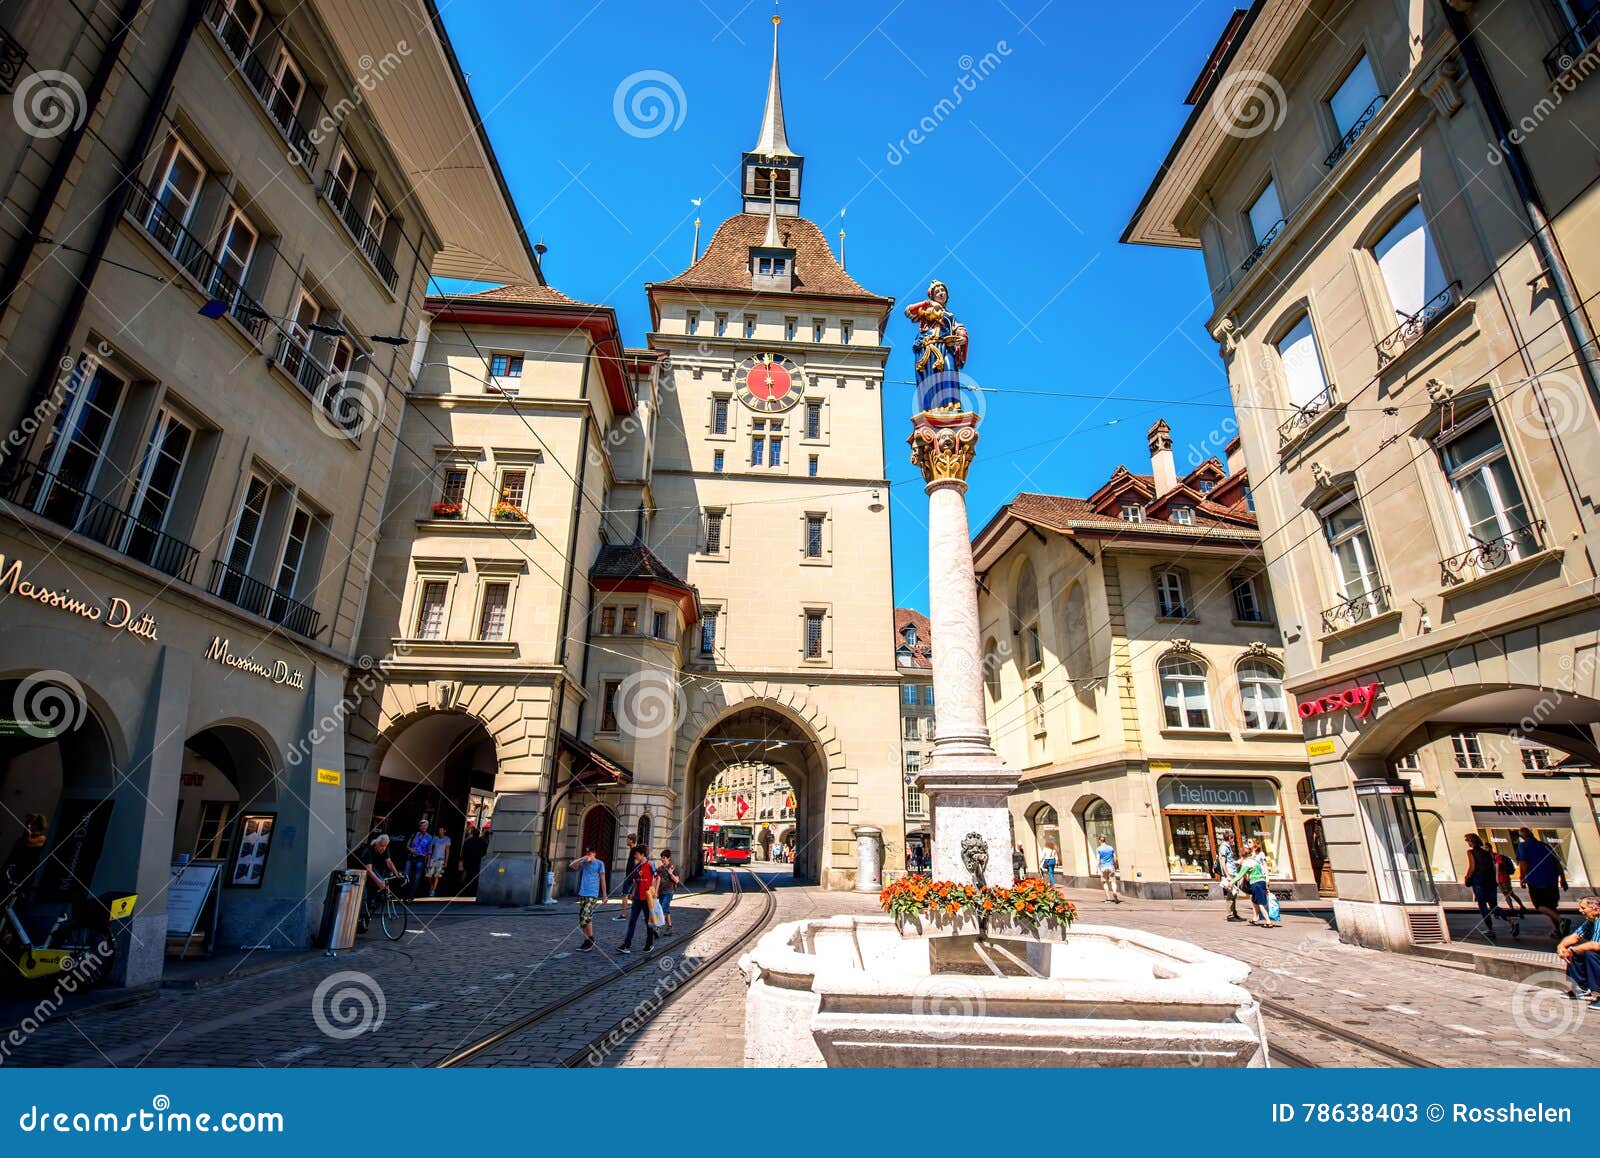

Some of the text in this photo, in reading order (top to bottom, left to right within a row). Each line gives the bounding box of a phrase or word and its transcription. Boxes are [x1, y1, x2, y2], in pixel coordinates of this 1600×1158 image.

[0, 553, 159, 641] Massimo Dutti
[205, 636, 304, 690] Massimo Dutti
[1298, 682, 1379, 719] orsay
